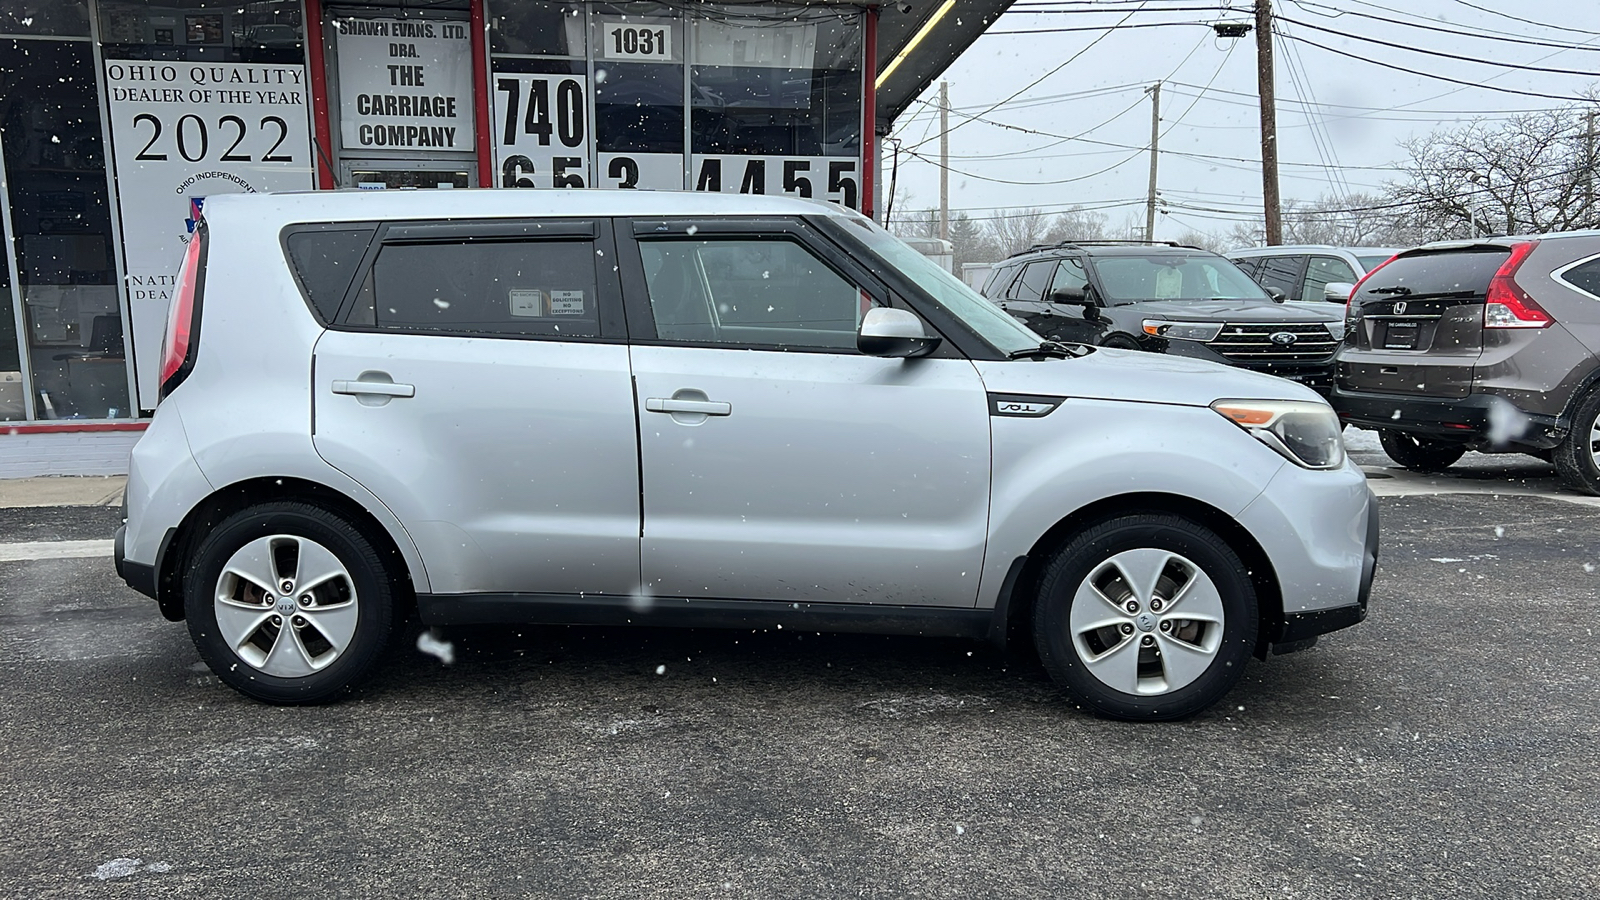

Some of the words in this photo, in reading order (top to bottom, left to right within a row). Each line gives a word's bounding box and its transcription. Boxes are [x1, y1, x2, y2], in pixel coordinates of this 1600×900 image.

[340, 21, 388, 36] SHAWN
[392, 23, 437, 38] EVANS.
[442, 25, 467, 39] LTD.
[611, 28, 665, 54] 1031
[389, 43, 420, 58] DBA.
[108, 64, 177, 82] OHIO
[190, 67, 303, 86] QUALITY
[387, 64, 425, 87] THE
[113, 87, 185, 102] DEALER
[189, 89, 211, 104] OF
[216, 90, 252, 104] THE
[256, 91, 302, 105] YEAR
[357, 93, 457, 118] CARRIAGE
[498, 78, 584, 148] 740
[133, 113, 293, 163] 2022
[359, 124, 456, 147] COMPANY
[176, 177, 195, 194] OHIO
[195, 171, 257, 194] INDEPENDENT
[136, 290, 173, 300] DEA
[1140, 615, 1152, 631] KIA
